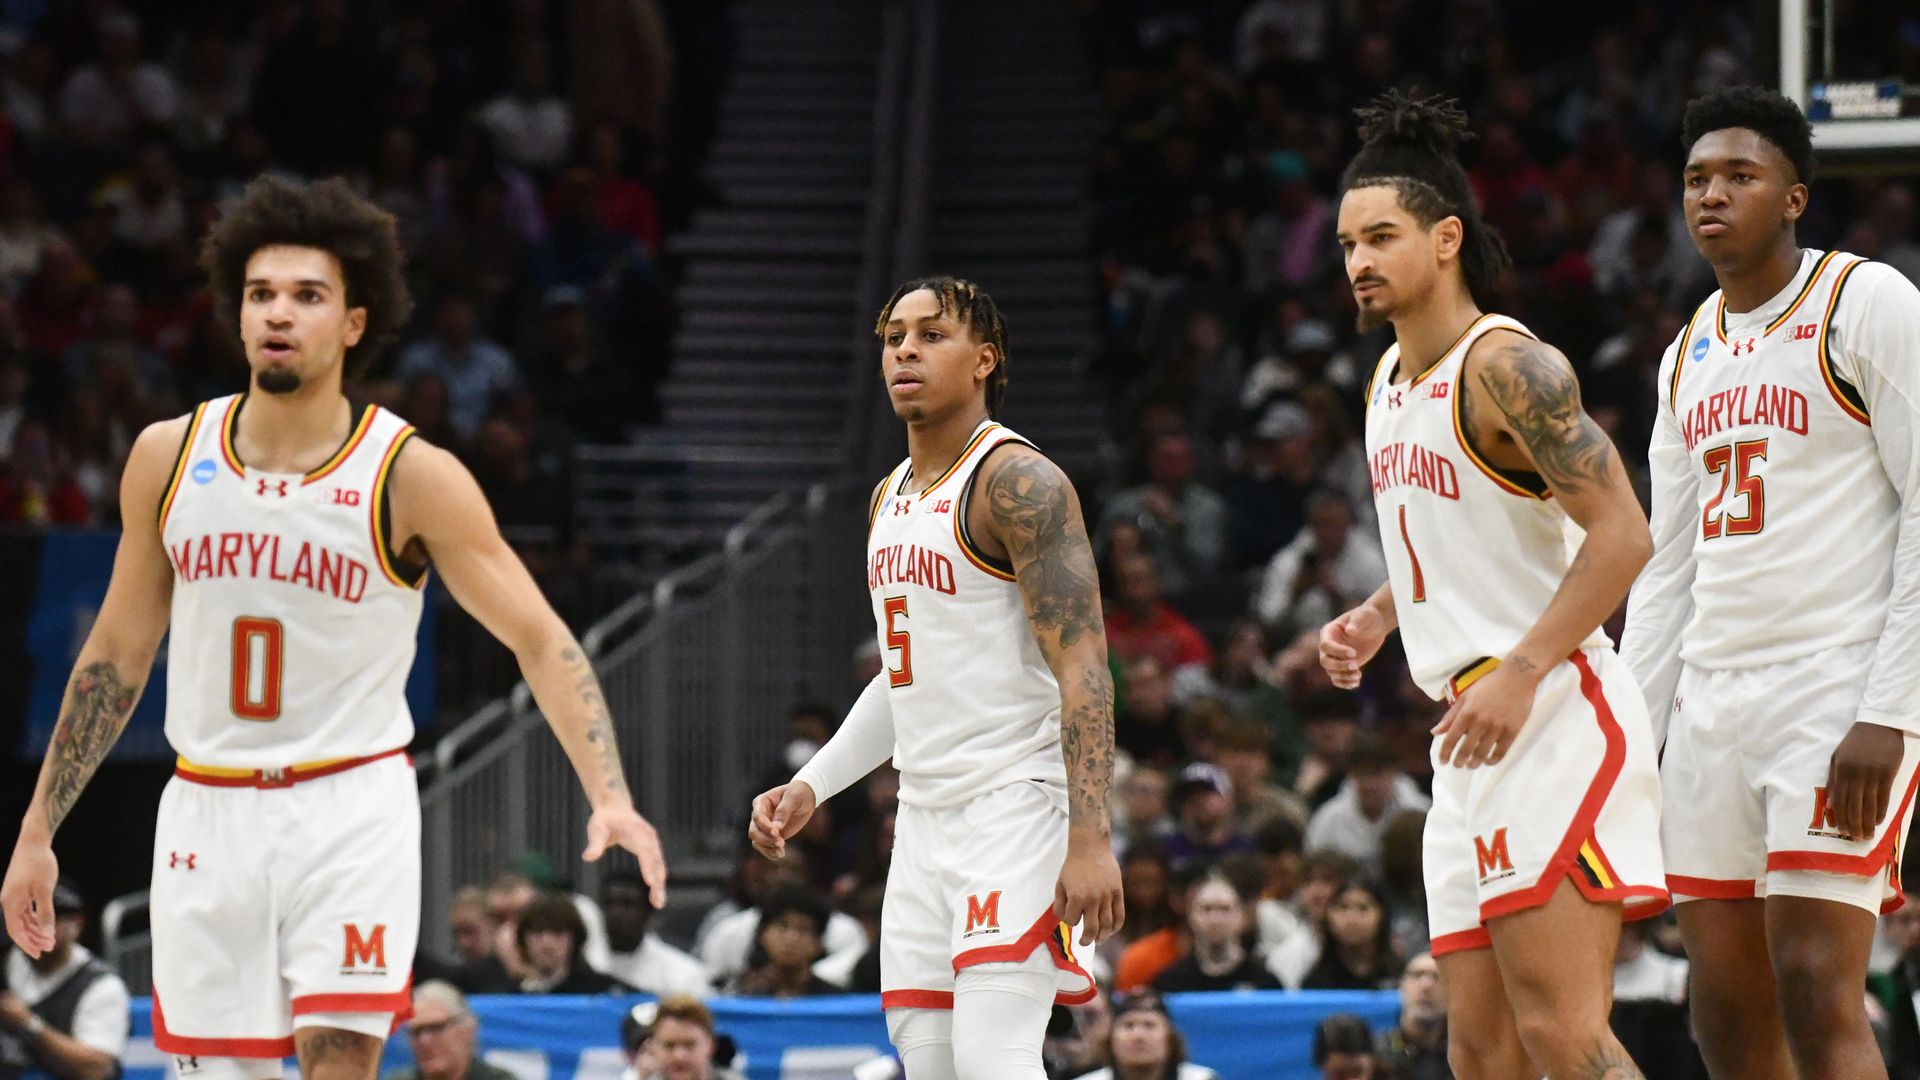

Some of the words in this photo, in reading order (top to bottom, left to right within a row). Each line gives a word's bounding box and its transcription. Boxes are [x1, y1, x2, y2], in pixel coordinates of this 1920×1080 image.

[1682, 383, 1809, 451] MARYLAND
[1703, 437, 1769, 541] 25
[172, 532, 368, 604] MARYLAND
[868, 544, 957, 595] ARYLAND
[1398, 504, 1426, 603] 1
[229, 615, 284, 722] 0
[884, 595, 913, 689] 5
[1473, 826, 1514, 880] M
[342, 923, 387, 968] M
[964, 890, 1002, 933] M
